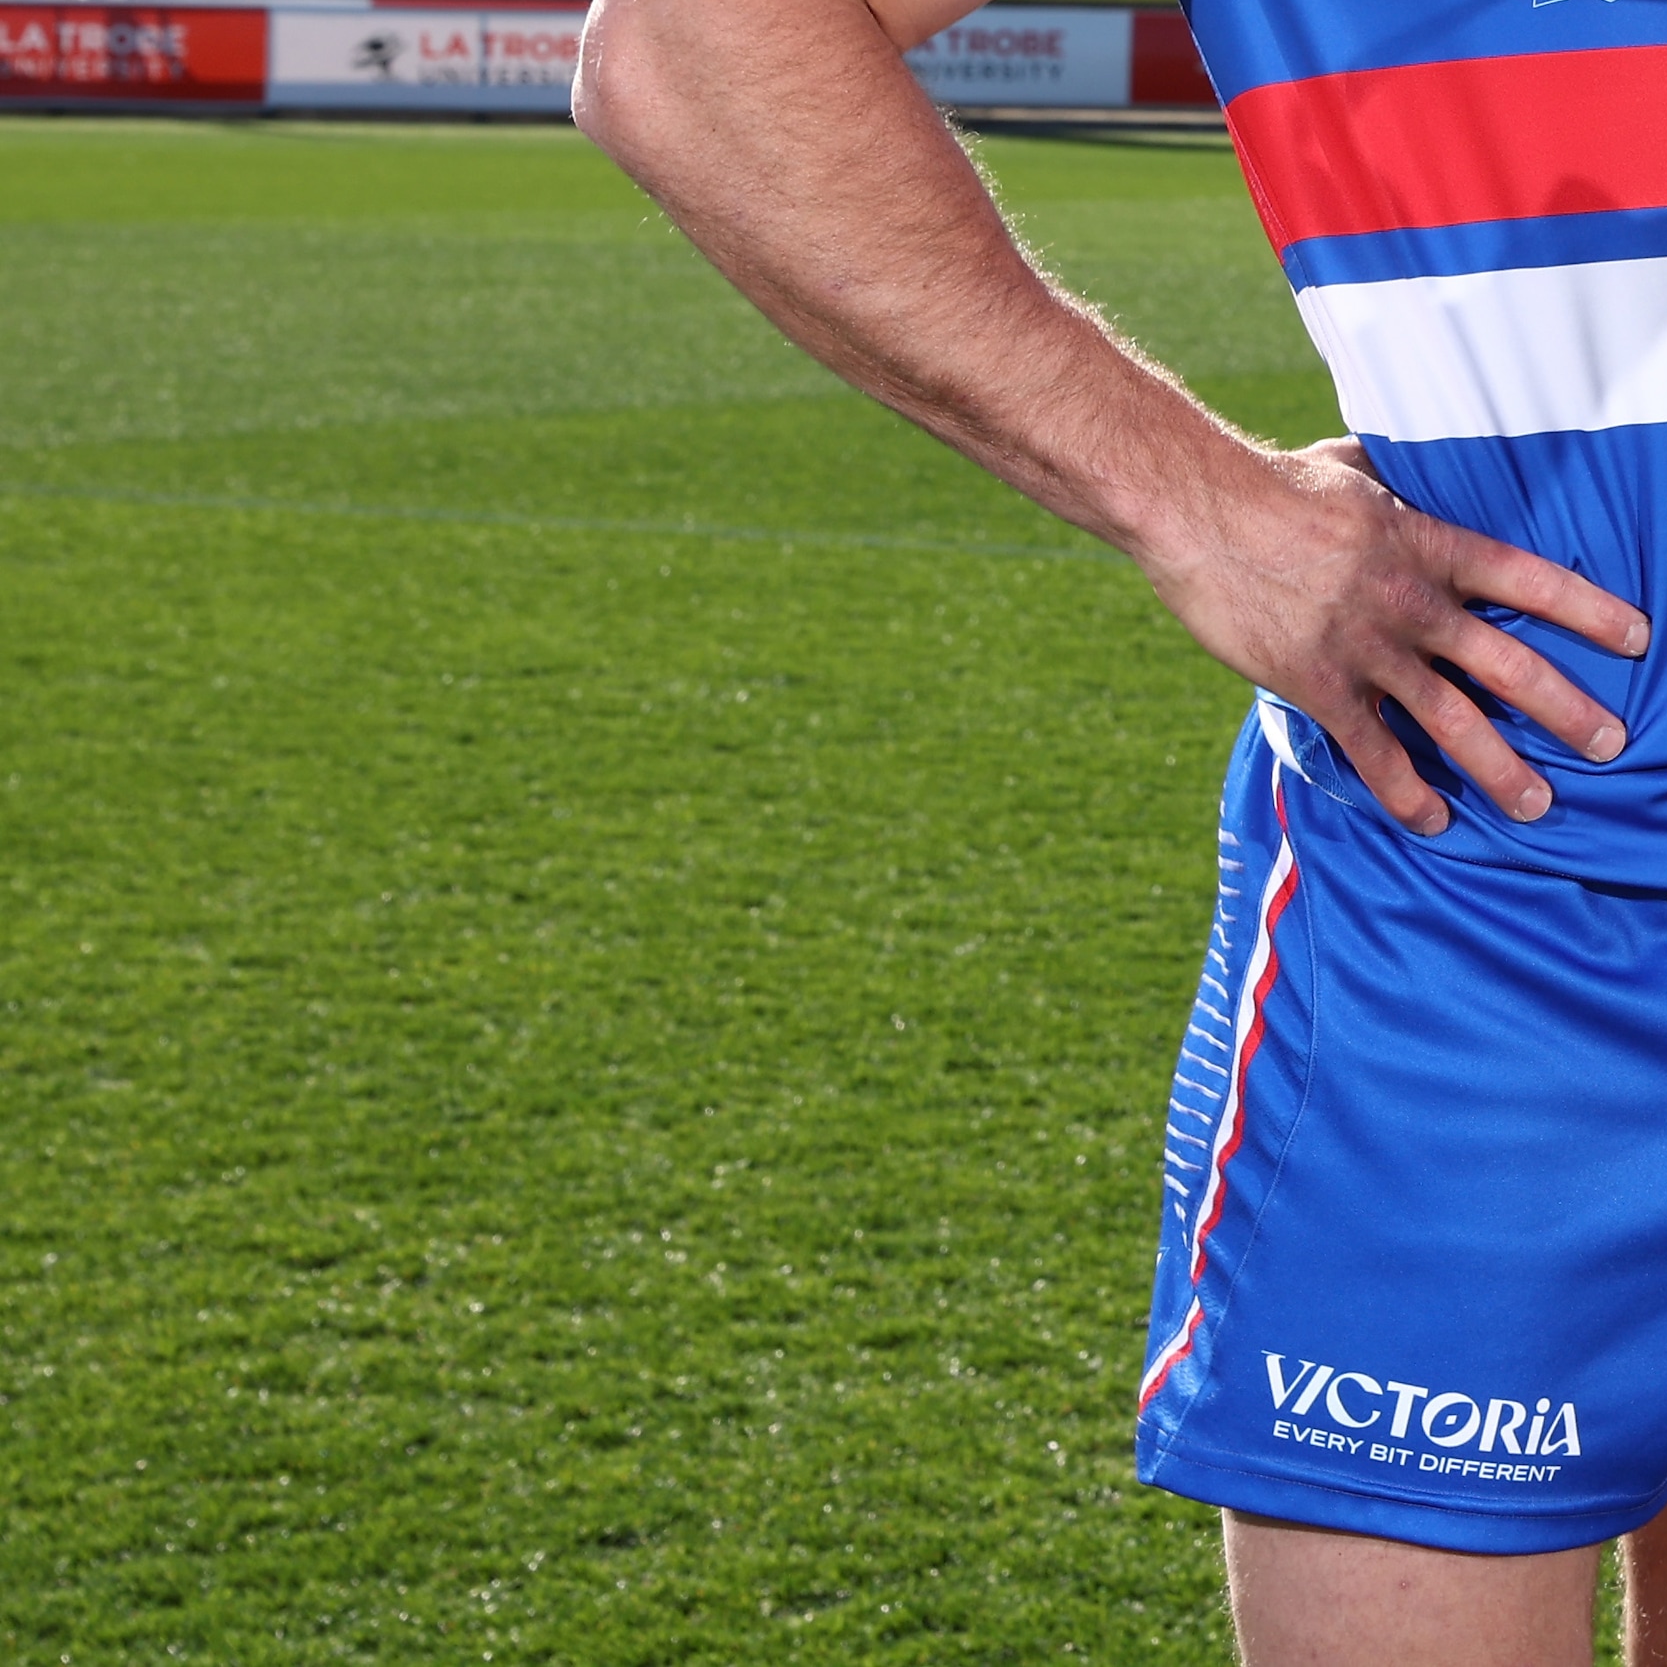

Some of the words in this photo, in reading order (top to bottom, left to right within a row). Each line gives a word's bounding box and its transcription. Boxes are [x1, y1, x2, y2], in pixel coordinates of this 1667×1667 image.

[418, 32, 469, 60] LA
[946, 29, 1064, 58] TROBE
[1272, 1419, 1364, 1455] EVERY
[1369, 1443, 1414, 1467] BIT
[1419, 1453, 1561, 1482] DIFFERENT
